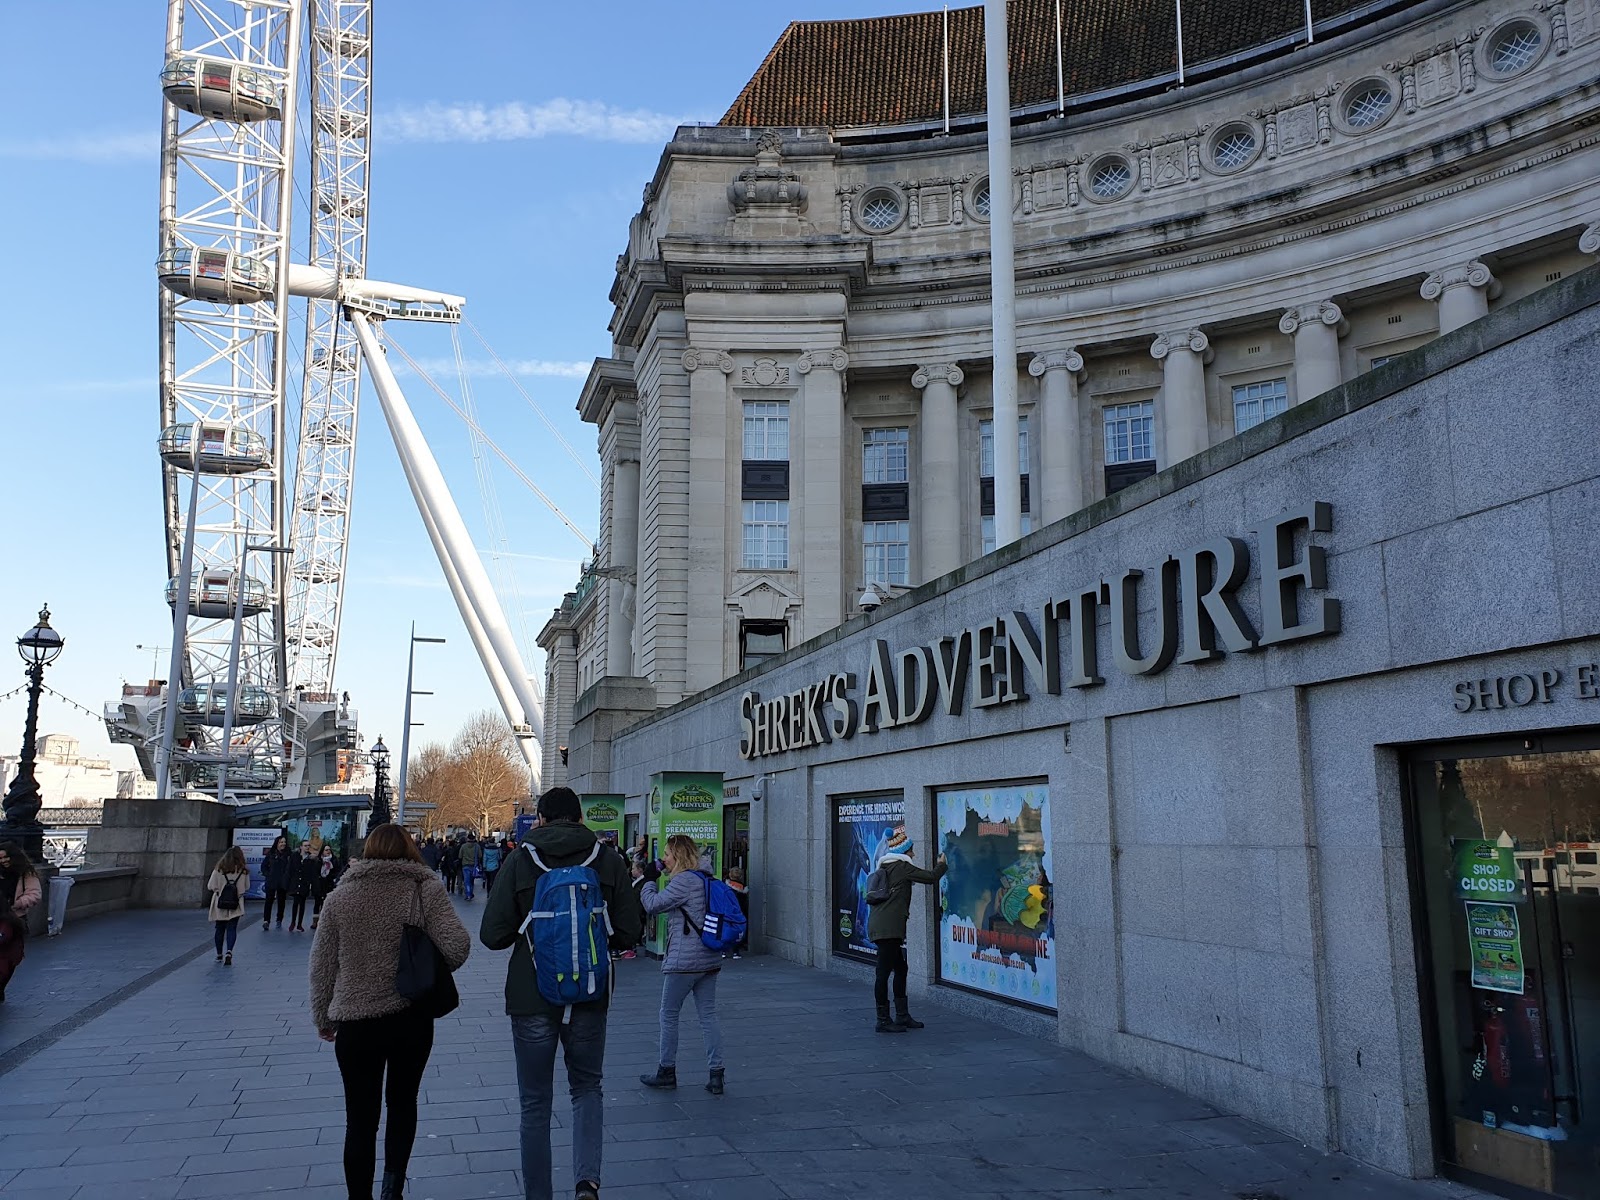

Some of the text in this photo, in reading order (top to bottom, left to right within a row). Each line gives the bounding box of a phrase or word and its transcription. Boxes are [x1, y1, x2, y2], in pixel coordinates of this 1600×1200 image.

[739, 501, 1340, 760] SHREK'S ADVENTURE
[1453, 668, 1560, 713] SHOP
[839, 803, 864, 816] EXPERIENCE
[865, 803, 874, 815] THE
[874, 802, 891, 814] HIDDEN
[1472, 864, 1500, 876] SHOP
[1461, 877, 1516, 893] CLOSED
[952, 924, 966, 943] BUY
[967, 926, 975, 945] IN
[1474, 926, 1514, 938] GIFT SHOP
